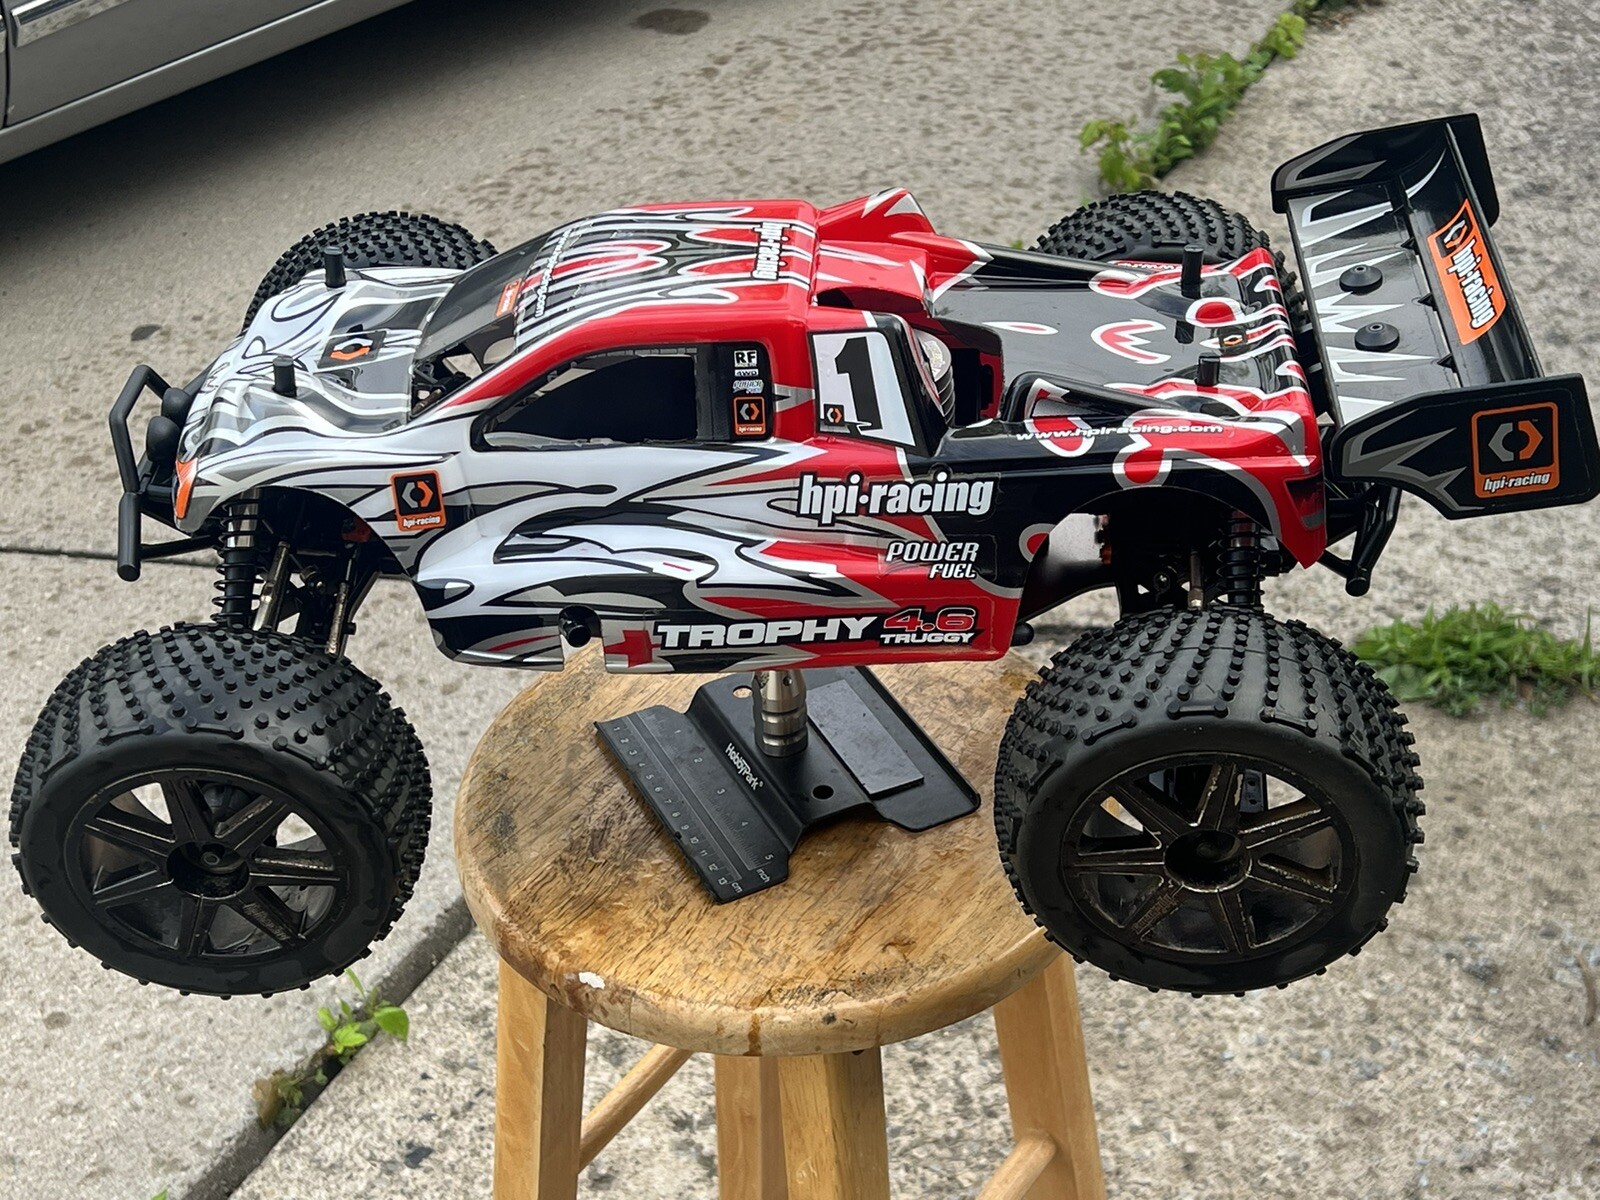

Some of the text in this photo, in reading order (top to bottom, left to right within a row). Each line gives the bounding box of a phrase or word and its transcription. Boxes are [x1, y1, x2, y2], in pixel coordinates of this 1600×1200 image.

[735, 351, 756, 364] RF
[736, 369, 758, 377] 4WD
[835, 336, 883, 431] 1
[1016, 424, 1223, 441] www.hpiracing.com
[886, 542, 980, 562] POWER
[929, 563, 977, 579] FUEL
[883, 607, 976, 632] 4.6
[658, 616, 878, 648] TROPHY
[880, 632, 975, 644] TRUGGY
[690, 836, 699, 844] 10
[700, 849, 708, 857] 11
[708, 863, 718, 872] 12
[718, 877, 728, 886] 13
[731, 882, 743, 893] cm
[756, 868, 771, 883] inch
